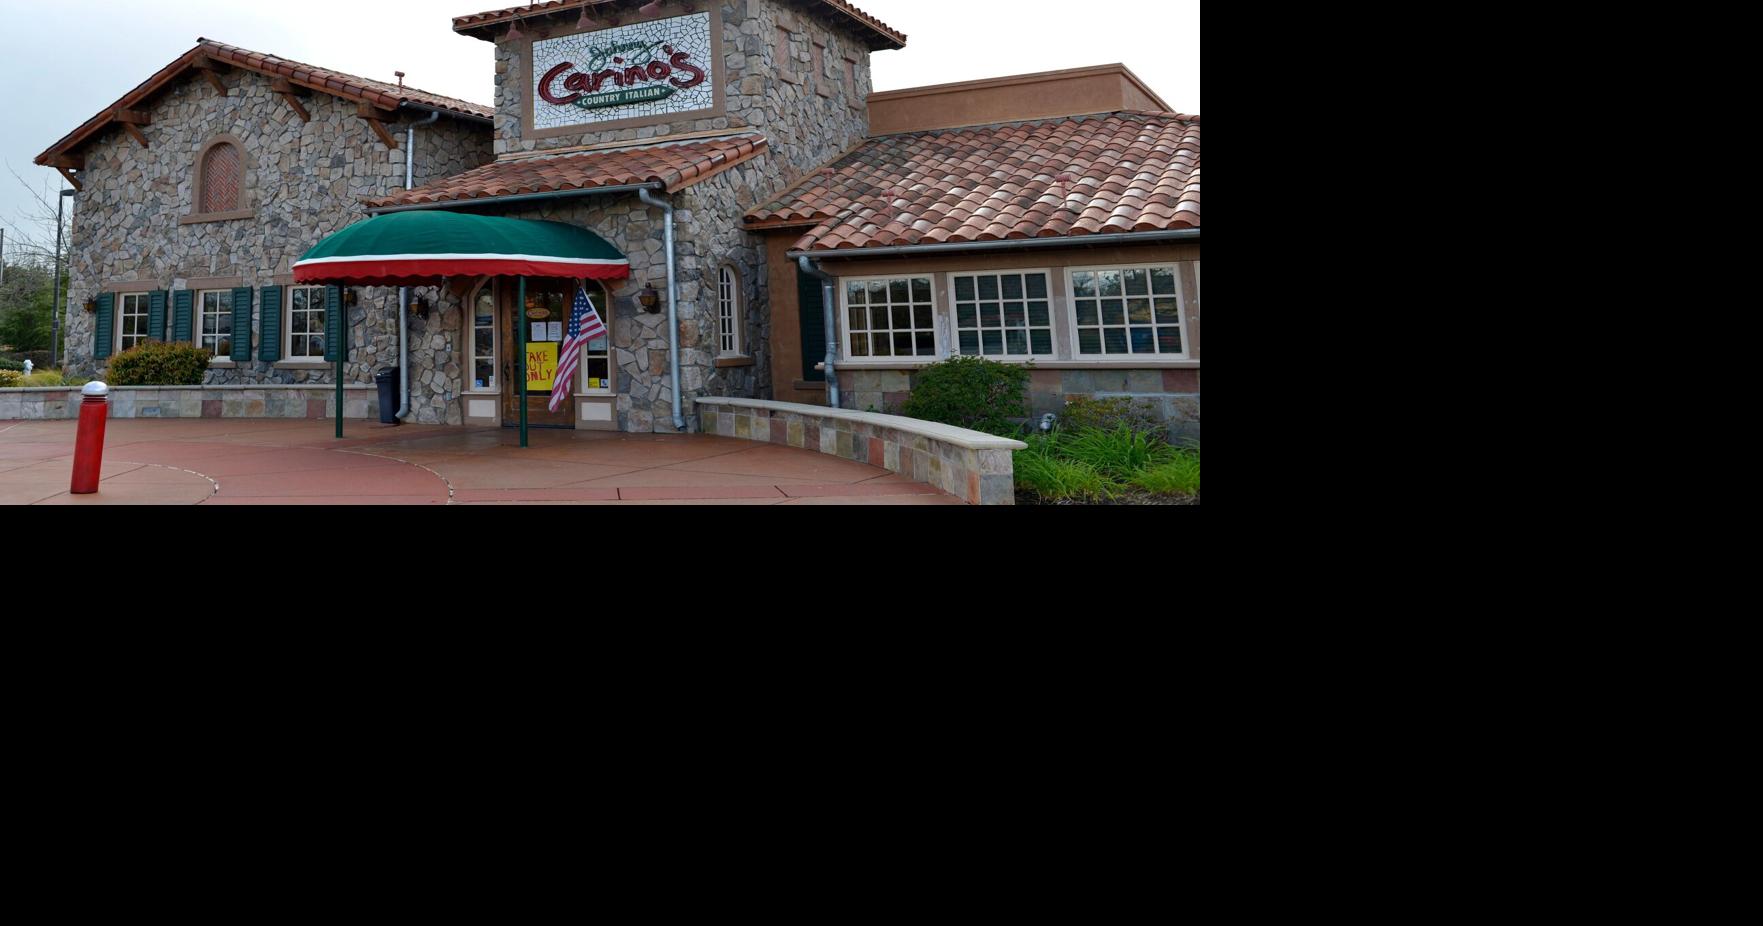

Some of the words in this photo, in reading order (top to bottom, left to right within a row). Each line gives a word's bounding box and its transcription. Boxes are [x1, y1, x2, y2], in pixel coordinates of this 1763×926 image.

[589, 39, 664, 71] Johnny
[582, 93, 620, 106] COUNTRY
[625, 87, 660, 100] ITALIAN
[527, 361, 544, 371] UT
